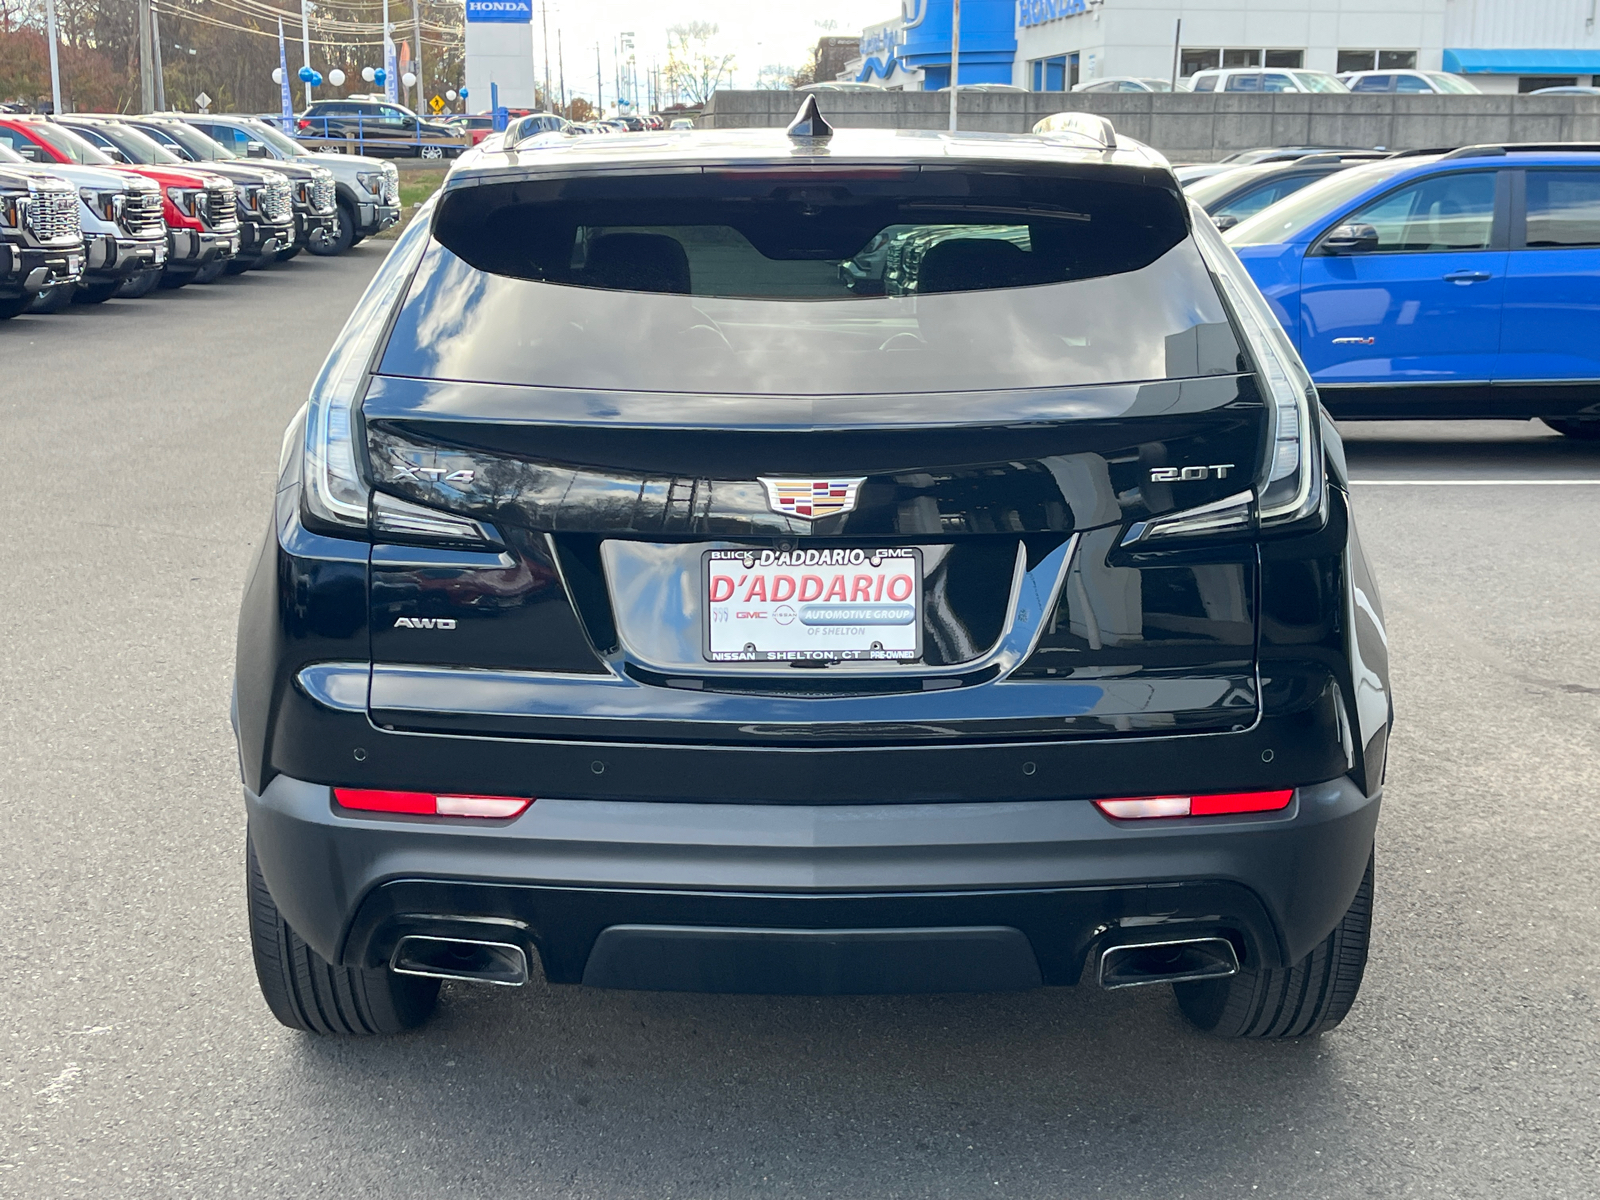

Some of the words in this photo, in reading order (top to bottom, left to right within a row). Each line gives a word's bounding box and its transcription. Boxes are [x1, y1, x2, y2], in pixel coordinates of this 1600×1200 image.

[469, 2, 529, 11] HONDA
[392, 466, 475, 483] XT4
[711, 551, 754, 559] BUICK
[760, 549, 865, 566] D'ADDARIO
[876, 549, 913, 557] GMC
[710, 574, 913, 603] D'ADDARIO
[805, 610, 872, 619] AUTOMOTIVE
[873, 610, 910, 619] GROUP
[393, 617, 457, 630] AWD
[807, 627, 821, 635] OF
[821, 627, 866, 636] SHELTON
[712, 652, 755, 660] NISSAN
[767, 651, 838, 660] SHELTON,
[841, 651, 861, 659] CT
[870, 651, 914, 659] PRE-OWNED
